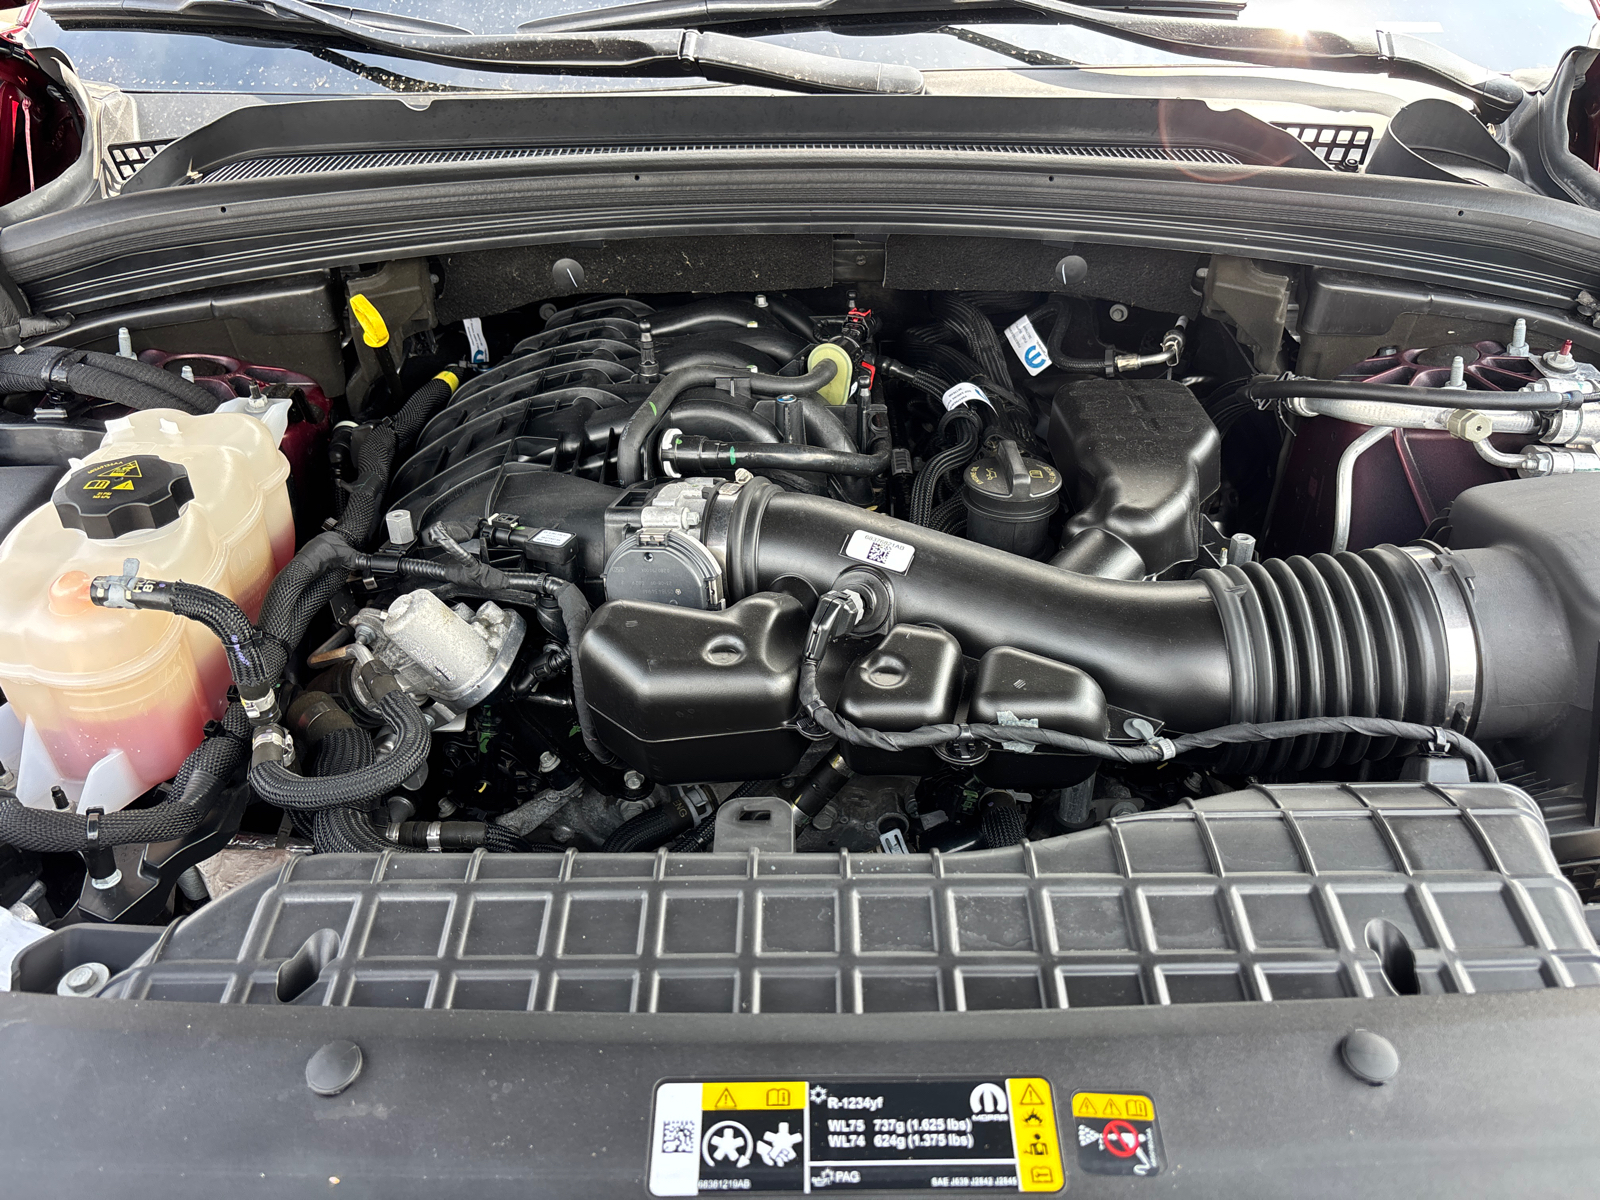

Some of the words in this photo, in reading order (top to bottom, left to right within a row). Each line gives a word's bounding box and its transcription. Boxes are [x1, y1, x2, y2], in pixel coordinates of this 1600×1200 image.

[827, 1096, 884, 1111] R-1234yf
[827, 1119, 865, 1132] WL75
[873, 1119, 905, 1134] 737g
[906, 1118, 946, 1133] (1.625
[946, 1118, 973, 1133] lbs)
[827, 1134, 866, 1148] WL74
[873, 1134, 906, 1150] 624g
[907, 1134, 947, 1149] (1.375
[948, 1133, 974, 1149] lbs)
[835, 1170, 861, 1183] PAG
